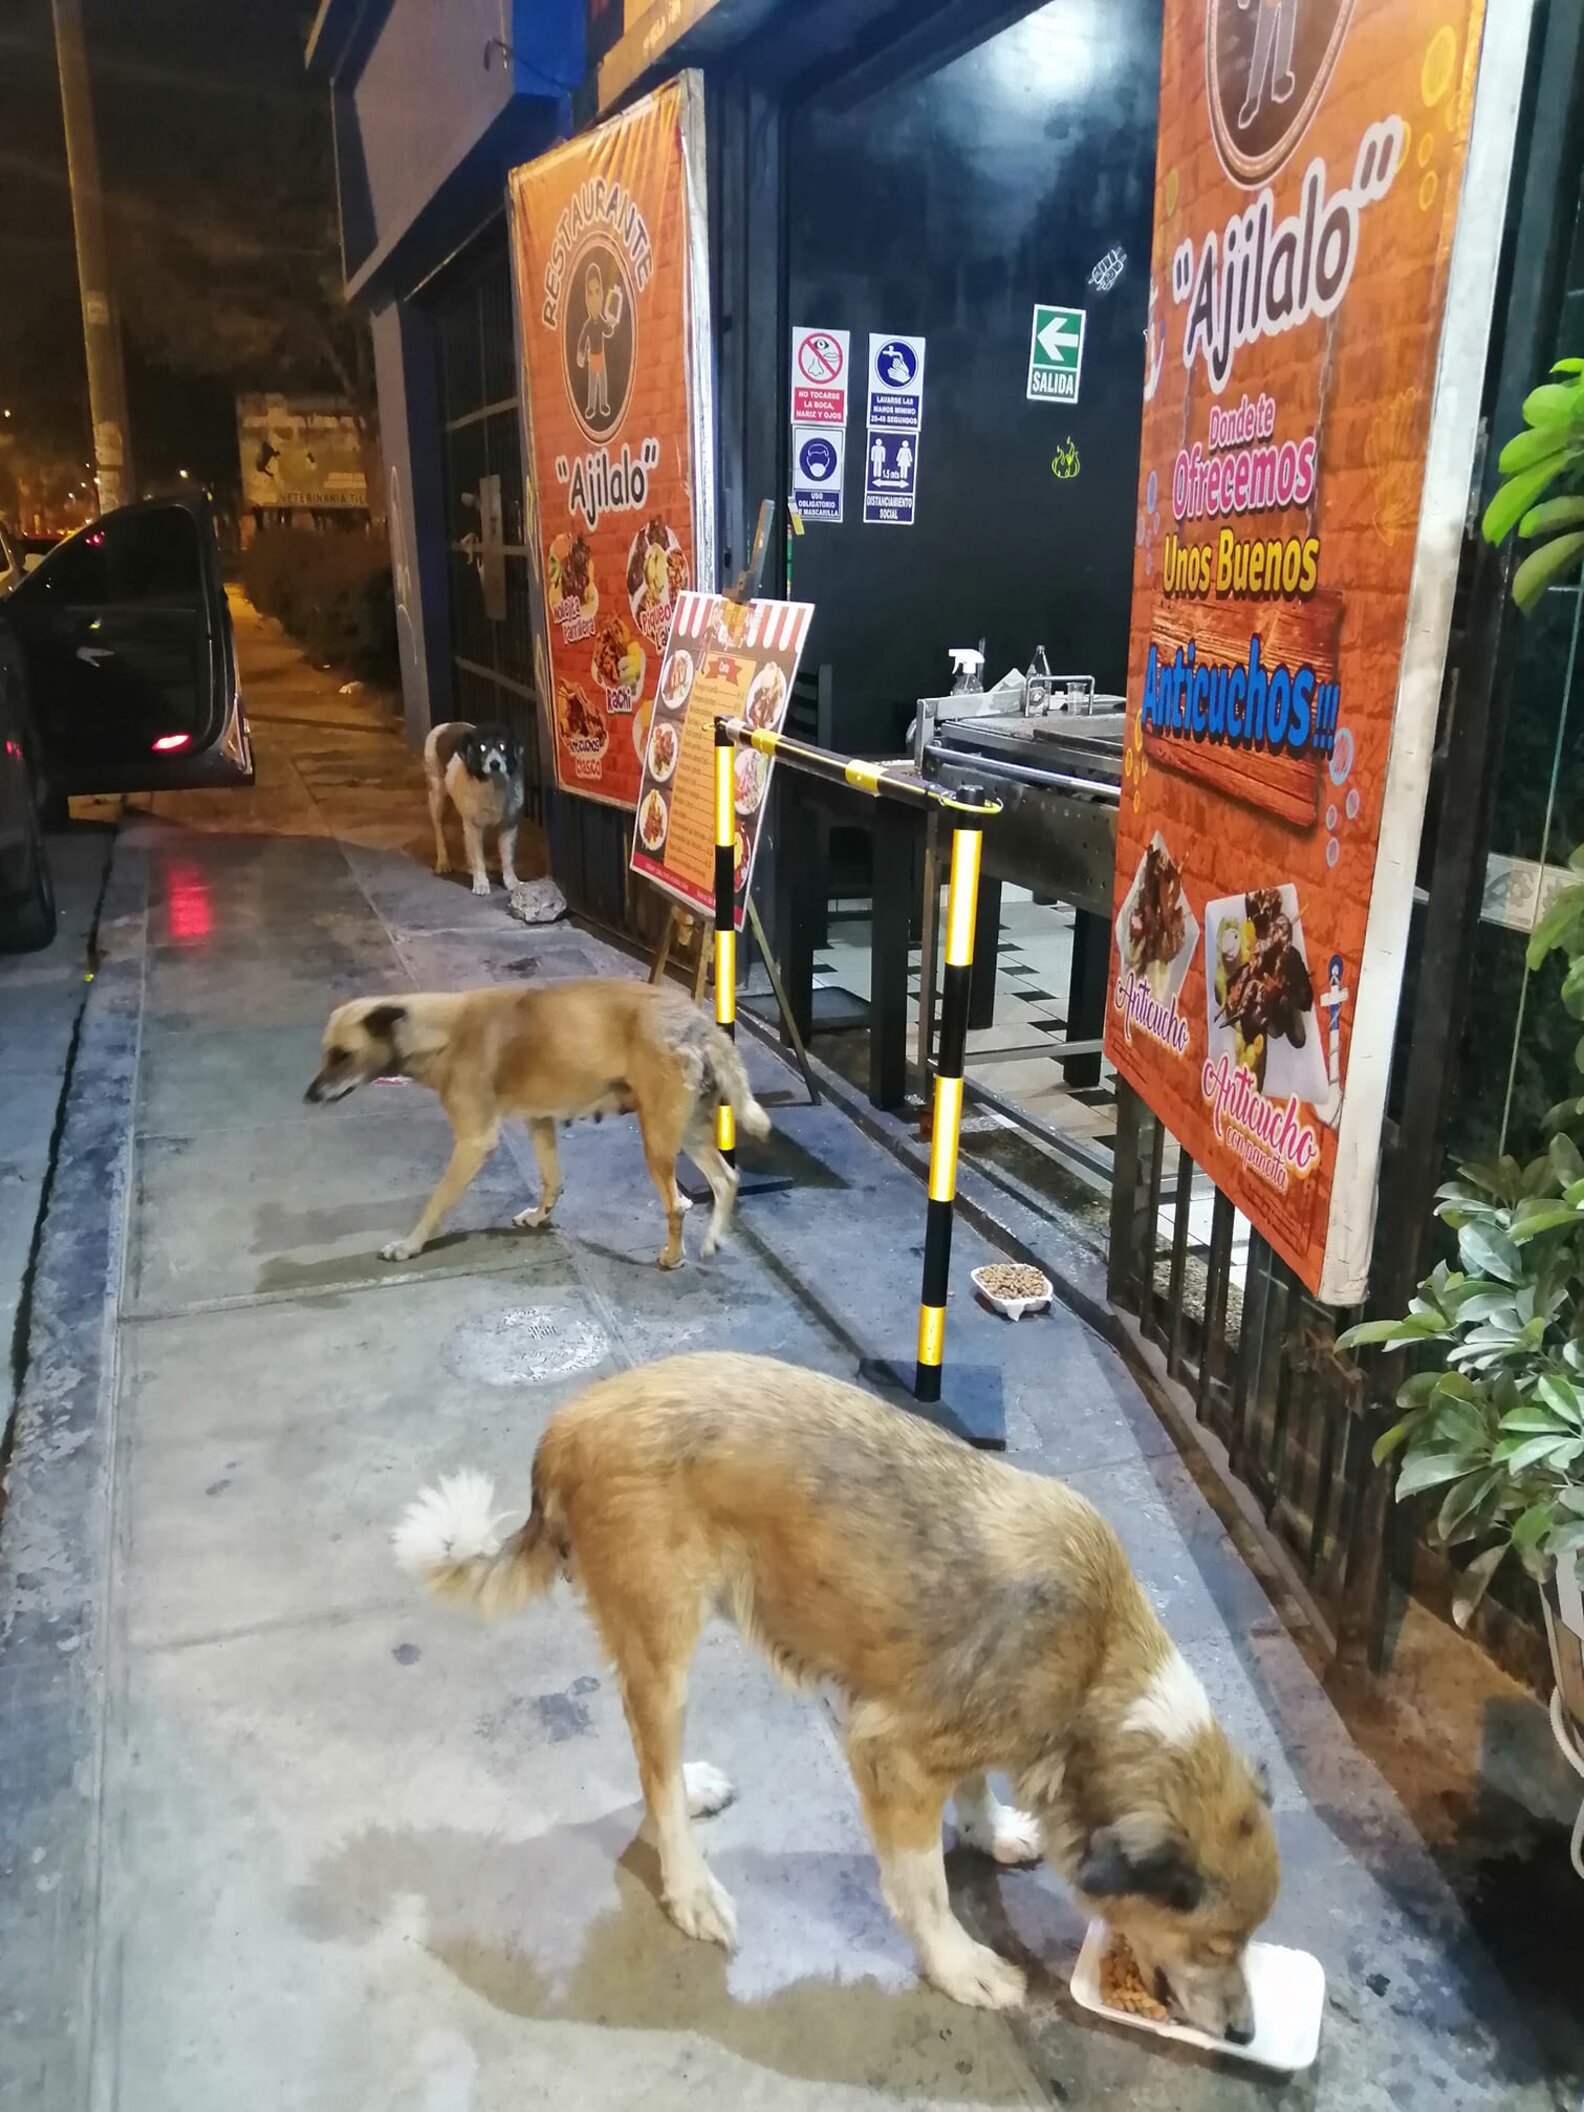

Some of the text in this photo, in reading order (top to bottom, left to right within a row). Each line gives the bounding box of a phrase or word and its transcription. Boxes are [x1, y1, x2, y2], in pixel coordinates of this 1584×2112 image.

[542, 176, 653, 330] RESTAURANTE
[1032, 372, 1074, 396] SALIDA
[798, 391, 840, 400] NO TOCARSE
[876, 396, 914, 405] LAVARSE LAS
[804, 401, 834, 410] LA BOCA,
[873, 405, 894, 414] MANOS
[796, 410, 816, 418] NARIZ
[823, 412, 842, 420] OJOS
[886, 415, 918, 425] SEGUNDOS
[1208, 393, 1276, 450] Donde te
[1173, 437, 1317, 520] Ofrecemos
[810, 492, 824, 500] USO
[866, 495, 913, 508] DISTANCIAMIENTO
[798, 500, 836, 509] OBLIGATORIO
[803, 508, 839, 517] MASCARILLA
[879, 507, 899, 520] SOCIAL
[1163, 527, 1320, 594] Unos Buenos
[1114, 971, 1190, 1053] Anticucho
[1203, 1054, 1319, 1170] Anticucho
